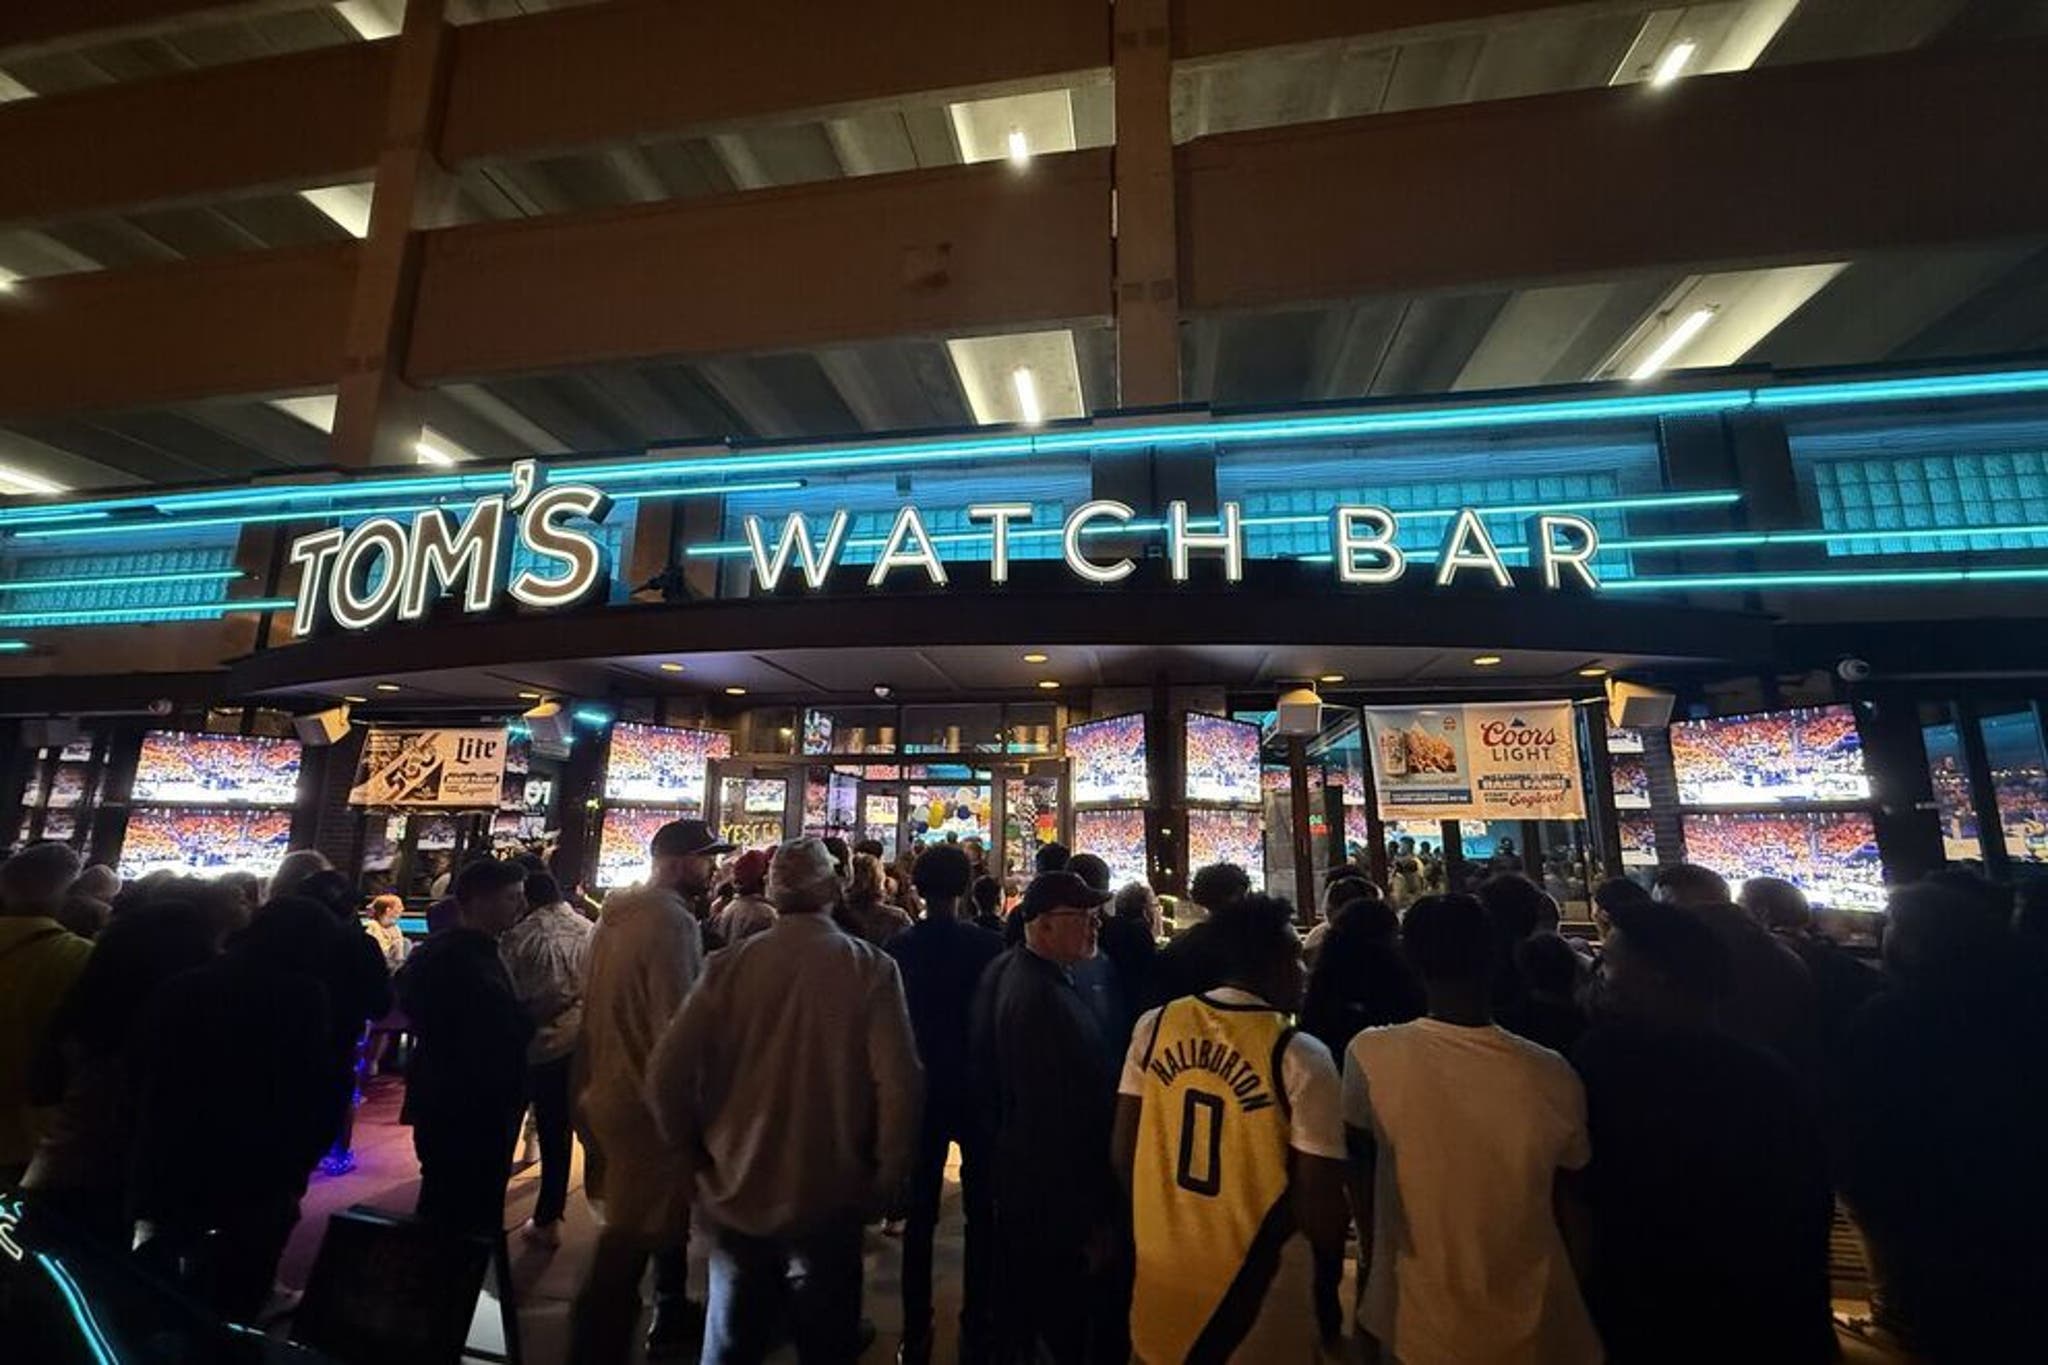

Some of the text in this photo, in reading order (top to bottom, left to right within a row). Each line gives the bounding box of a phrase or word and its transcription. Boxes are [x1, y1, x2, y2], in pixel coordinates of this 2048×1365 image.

[290, 458, 611, 636] TOM'S
[744, 499, 1602, 592] WATCH BAR
[455, 736, 497, 764] Lite
[1481, 720, 1556, 748] Coors
[1493, 746, 1551, 763] LIGHT
[1150, 1039, 1274, 1113] HALIBURTON
[1177, 1088, 1224, 1197] 0
